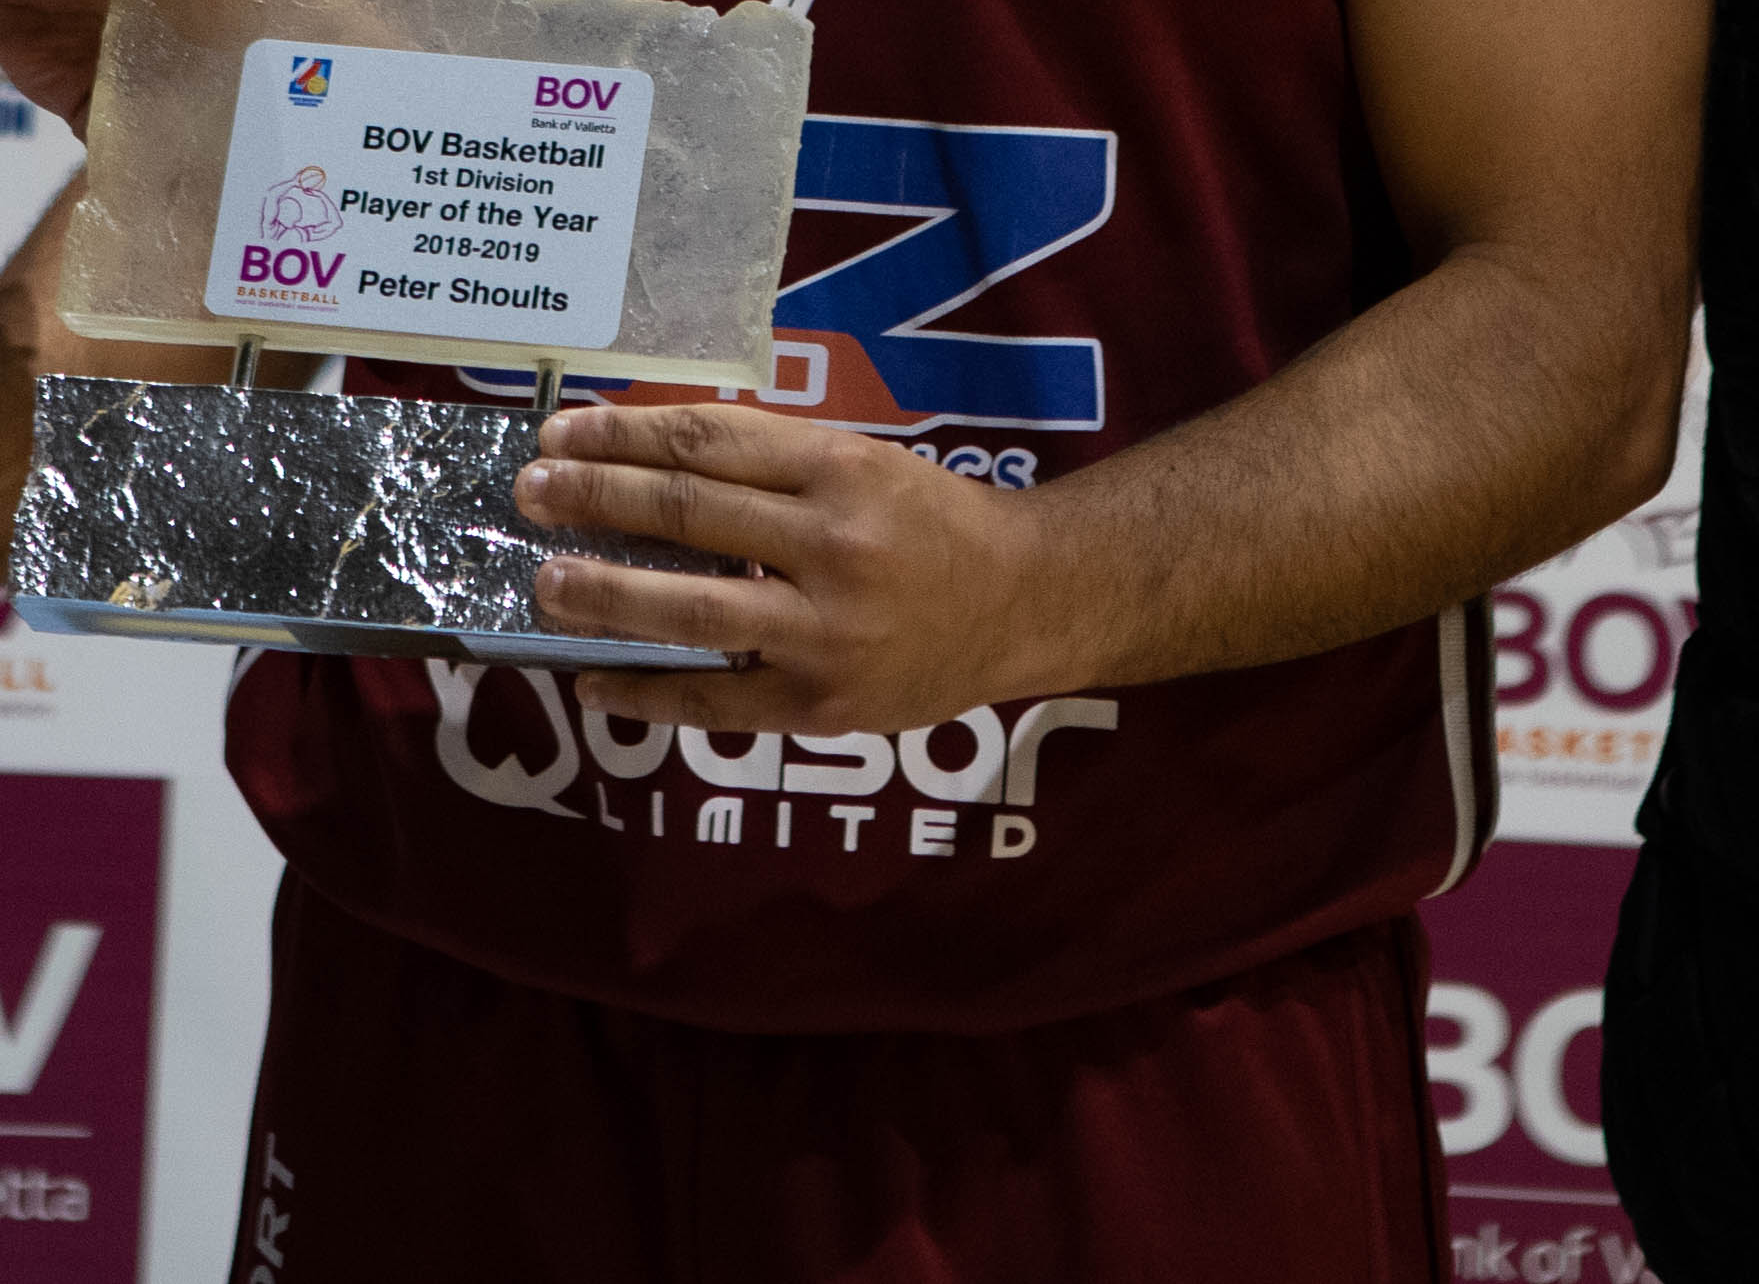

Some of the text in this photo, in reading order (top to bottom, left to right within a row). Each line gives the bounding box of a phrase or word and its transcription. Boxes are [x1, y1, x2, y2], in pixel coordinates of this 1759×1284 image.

[534, 76, 621, 111] BOV
[531, 117, 616, 134] Bank of Valletta
[362, 126, 604, 168] BOV Basketball
[411, 166, 554, 195] 1st Division
[341, 189, 598, 232] Player of the Year
[241, 245, 346, 288] BOV
[413, 234, 540, 262] 2018-2019
[237, 287, 339, 304] BASKETBALL
[358, 270, 569, 311] Peter Shoults
[1494, 589, 1701, 711] BO
[595, 780, 1038, 859] LIMITED
